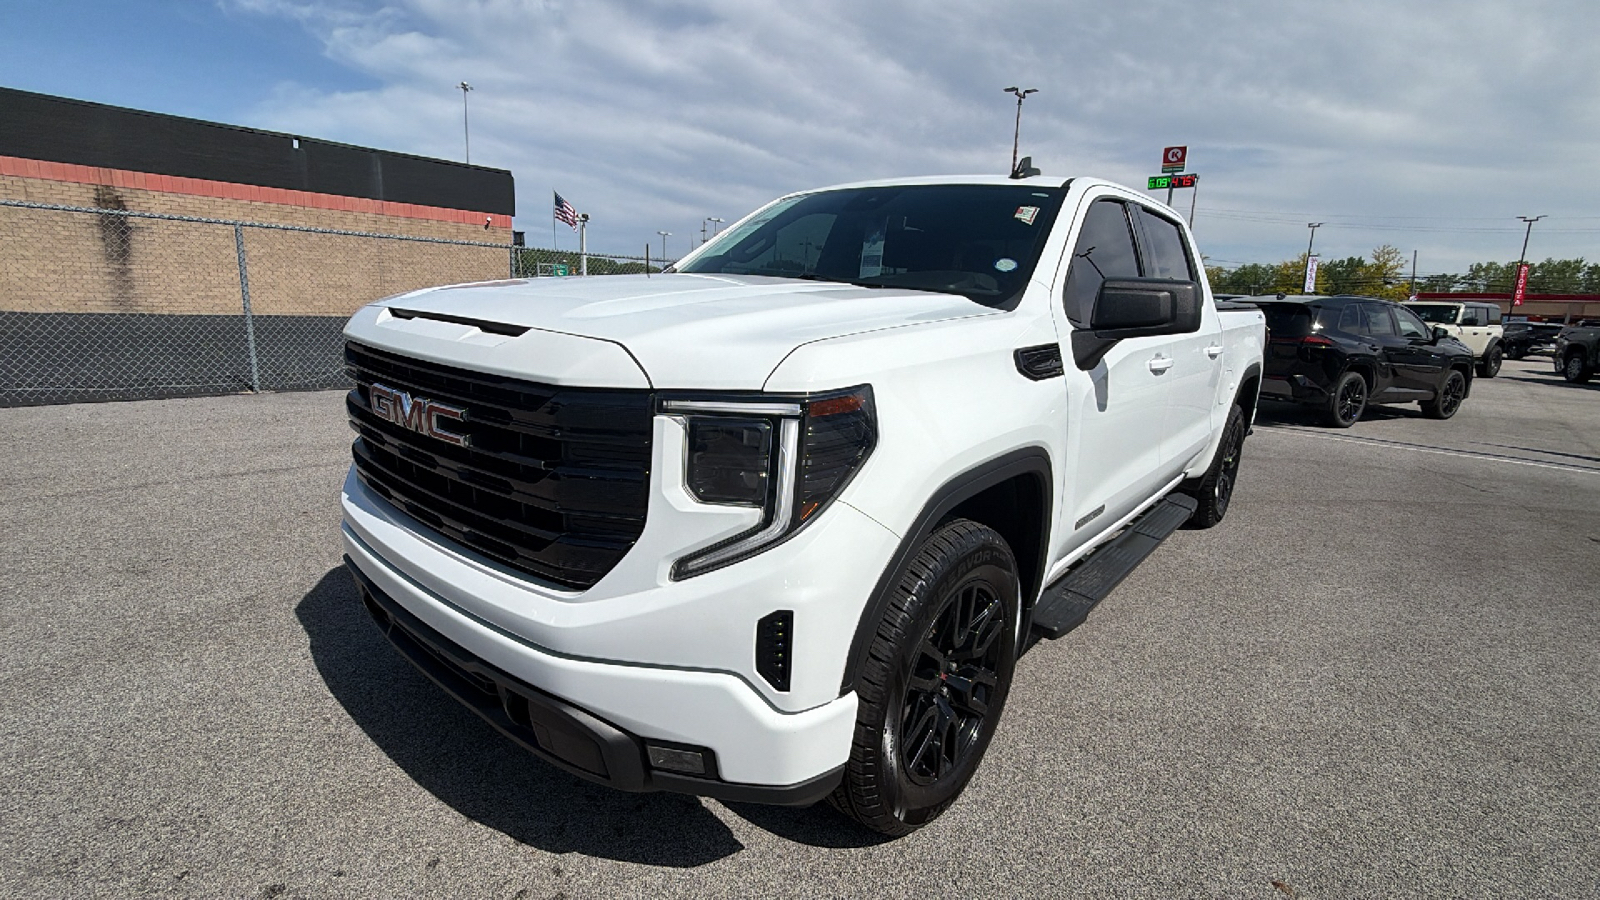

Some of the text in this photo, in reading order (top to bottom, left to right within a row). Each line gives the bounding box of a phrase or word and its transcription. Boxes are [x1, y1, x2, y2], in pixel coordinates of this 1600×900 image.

[1171, 151, 1180, 160] K
[1514, 273, 1525, 305] TOYOTA
[370, 383, 469, 447] GMC
